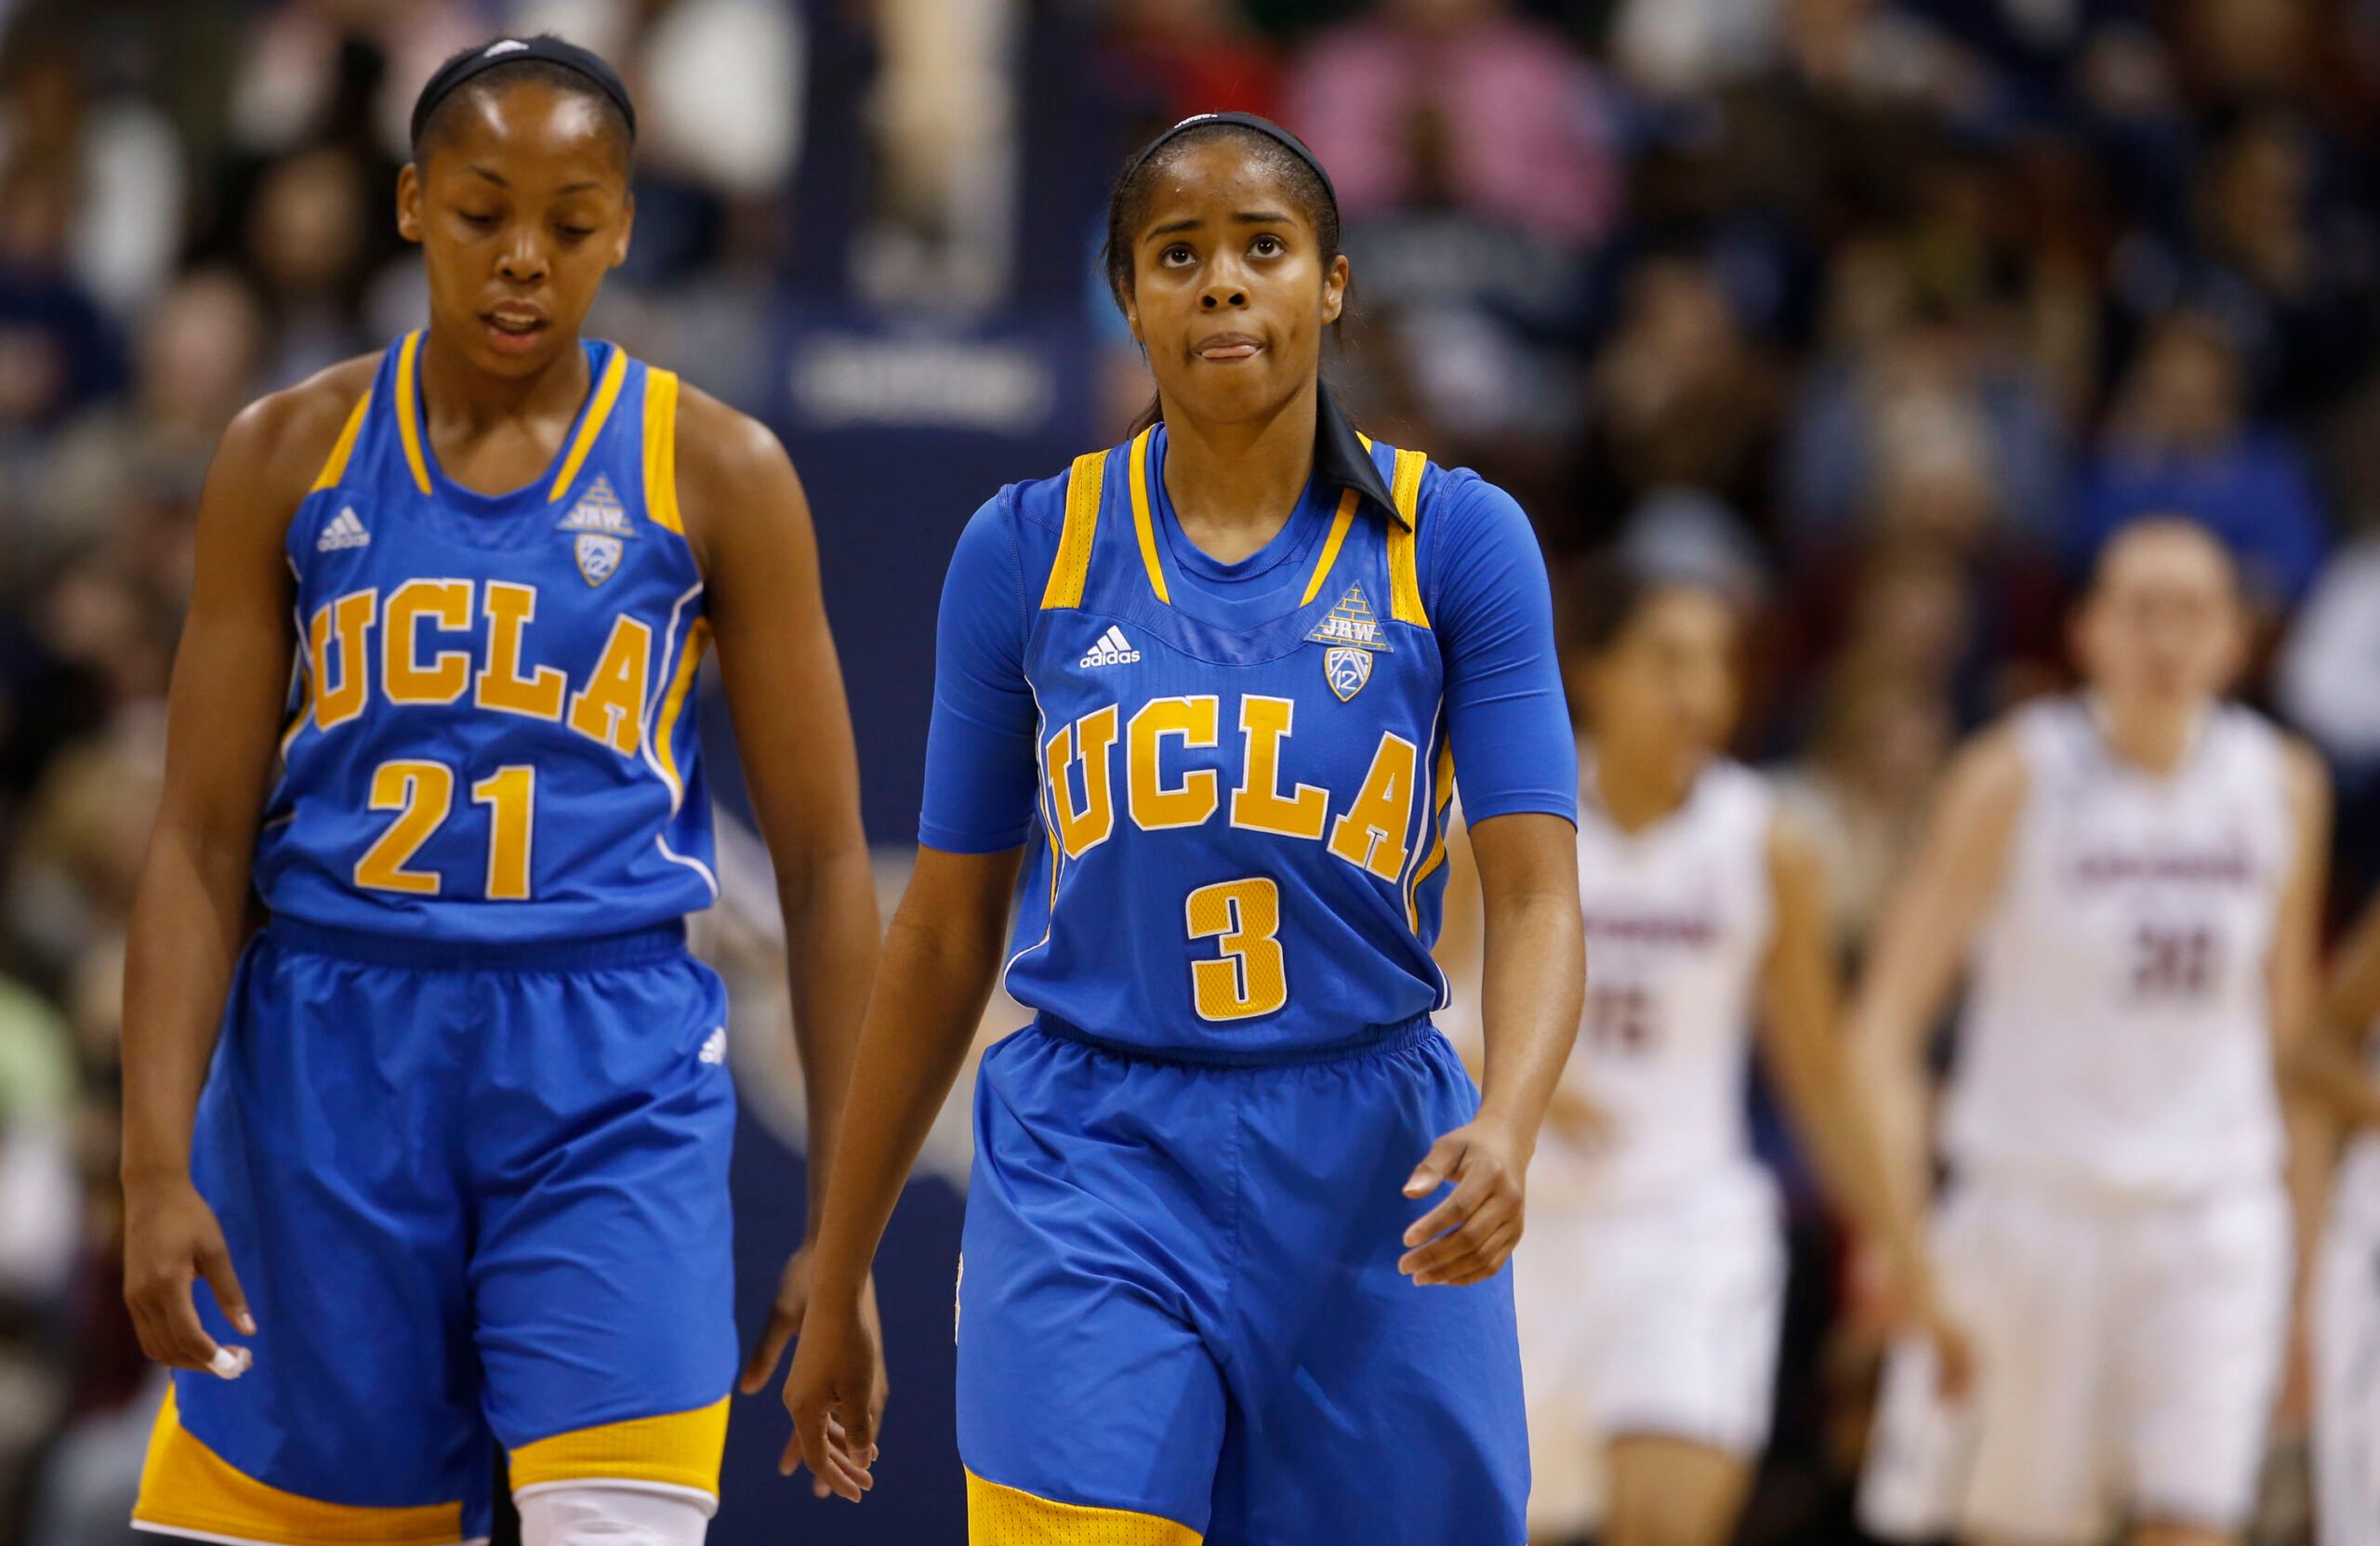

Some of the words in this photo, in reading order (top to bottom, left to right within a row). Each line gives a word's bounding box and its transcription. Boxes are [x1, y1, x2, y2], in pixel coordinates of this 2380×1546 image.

[311, 578, 652, 759] UCLA
[1079, 650, 1141, 668] adidas
[1323, 619, 1377, 642] JRW
[1330, 651, 1369, 681] PAC
[1337, 670, 1357, 690] 12
[354, 760, 536, 900] 21
[1045, 694, 1418, 883] UCLA
[1185, 876, 1287, 1022] 3
